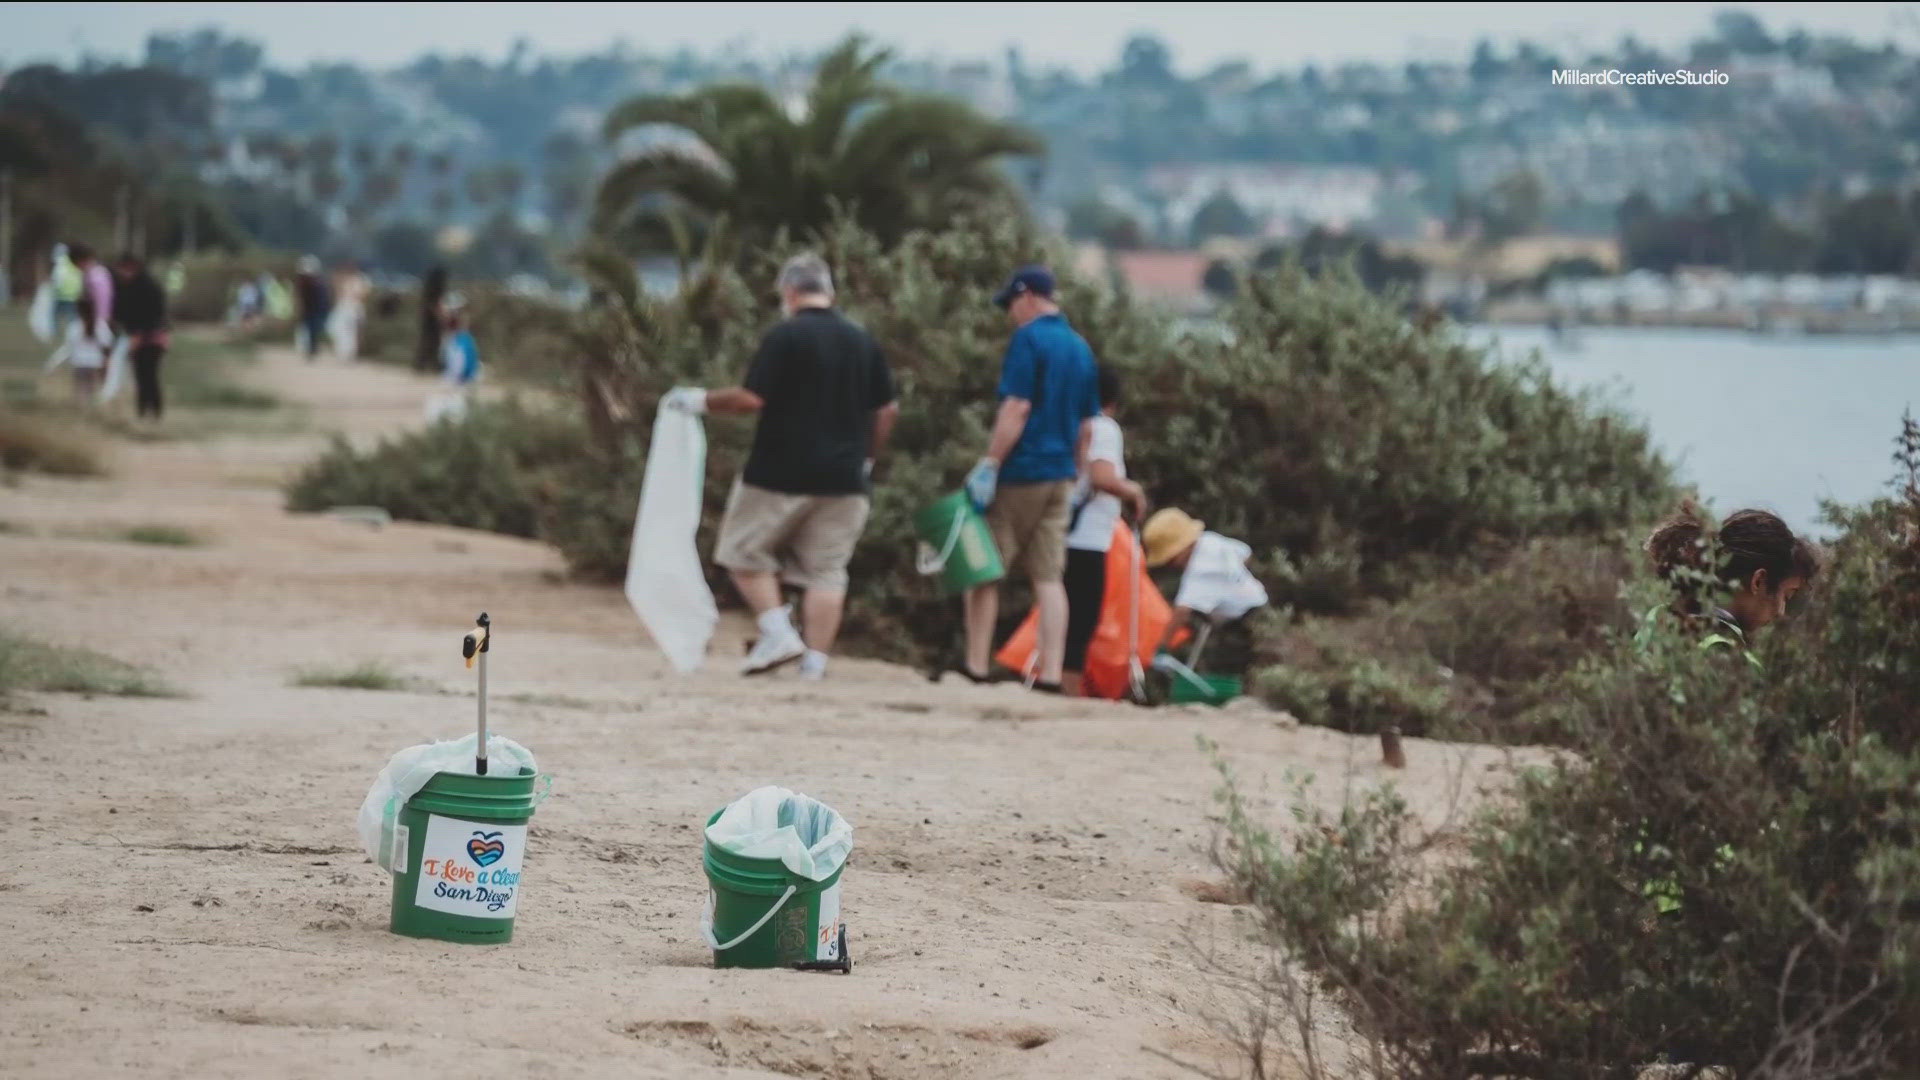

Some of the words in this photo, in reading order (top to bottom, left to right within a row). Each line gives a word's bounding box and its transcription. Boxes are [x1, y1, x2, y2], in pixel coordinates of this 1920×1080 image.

[424, 859, 440, 876] I
[440, 859, 475, 883] Love
[477, 871, 489, 884] a
[434, 881, 475, 901] San
[475, 887, 513, 912] Diego
